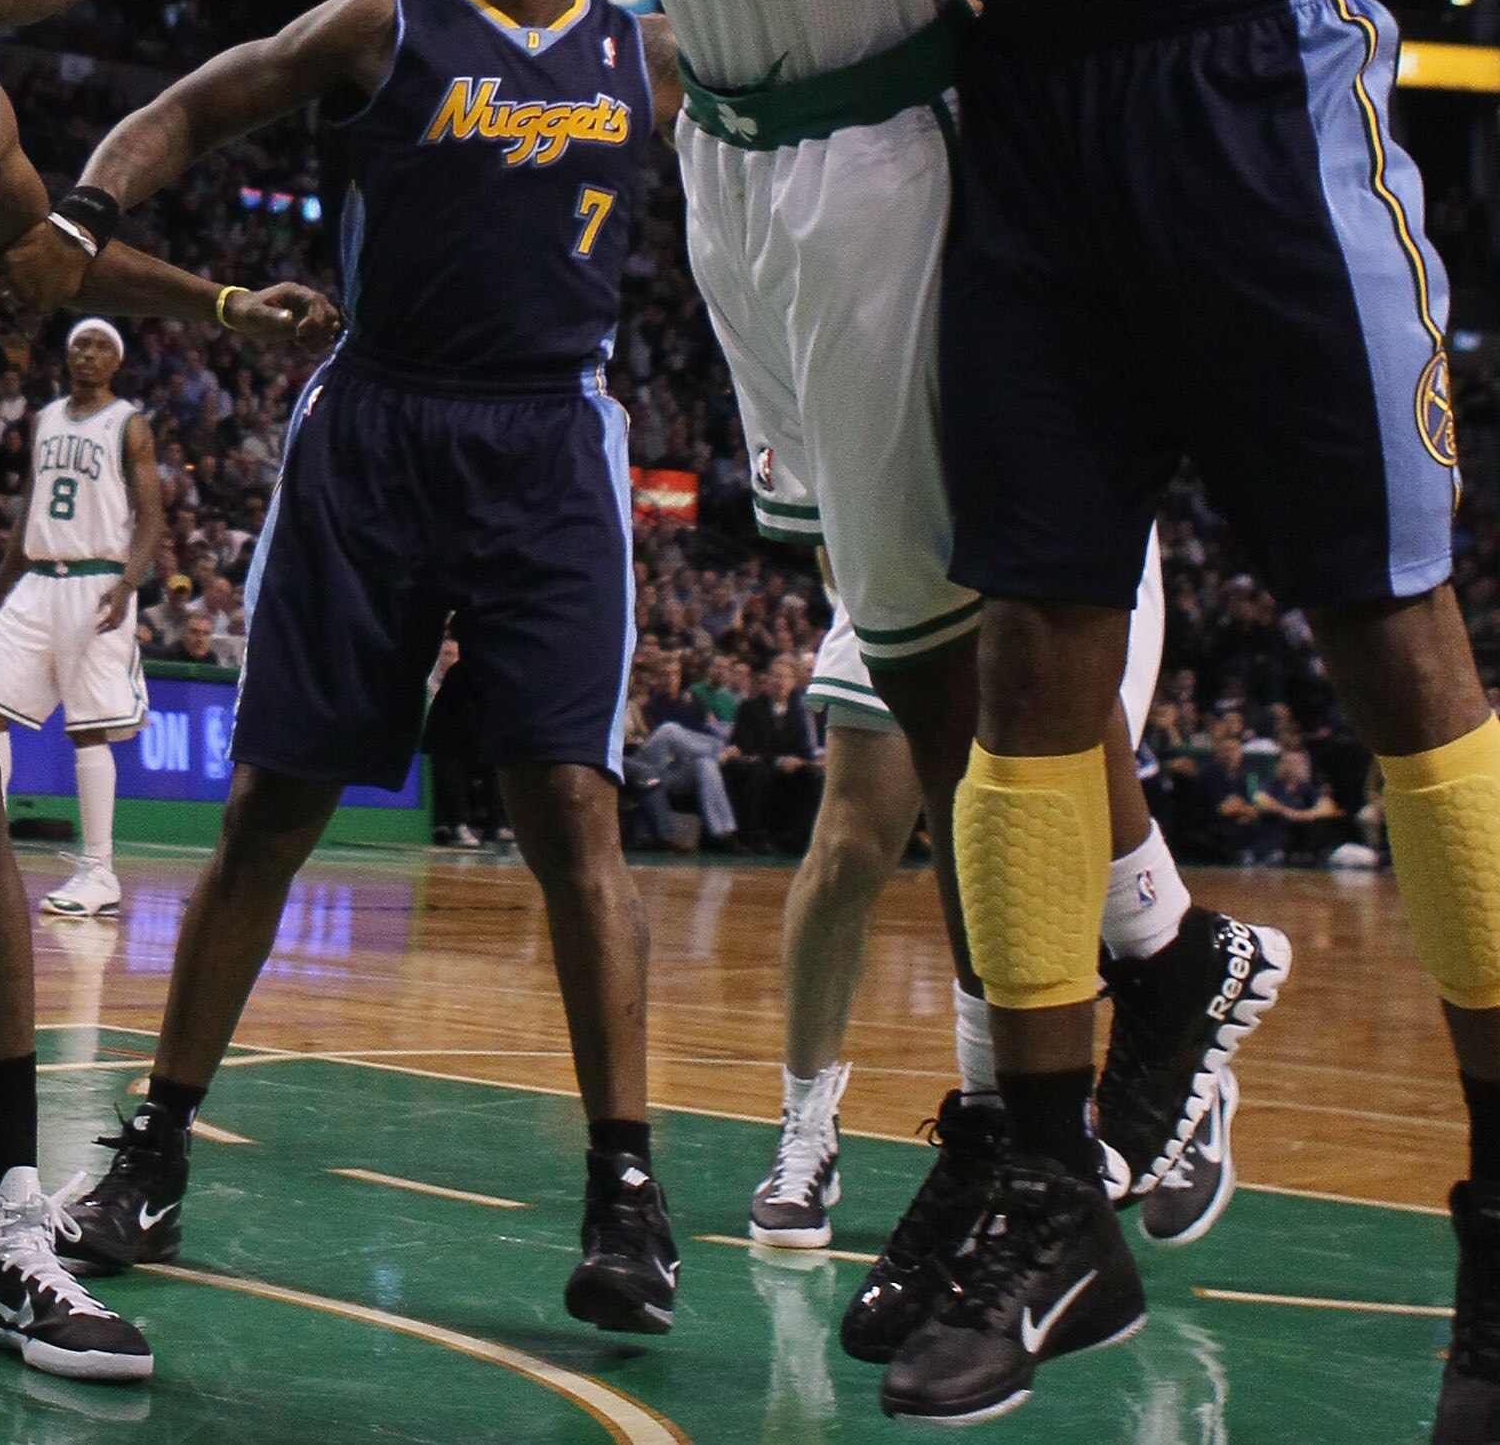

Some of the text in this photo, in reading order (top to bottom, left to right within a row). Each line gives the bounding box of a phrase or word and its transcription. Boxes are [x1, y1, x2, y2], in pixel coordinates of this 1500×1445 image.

[422, 79, 632, 166] Nuggets
[574, 185, 617, 257] 7
[49, 476, 78, 521] 8
[1206, 913, 1255, 1022] Reebo
